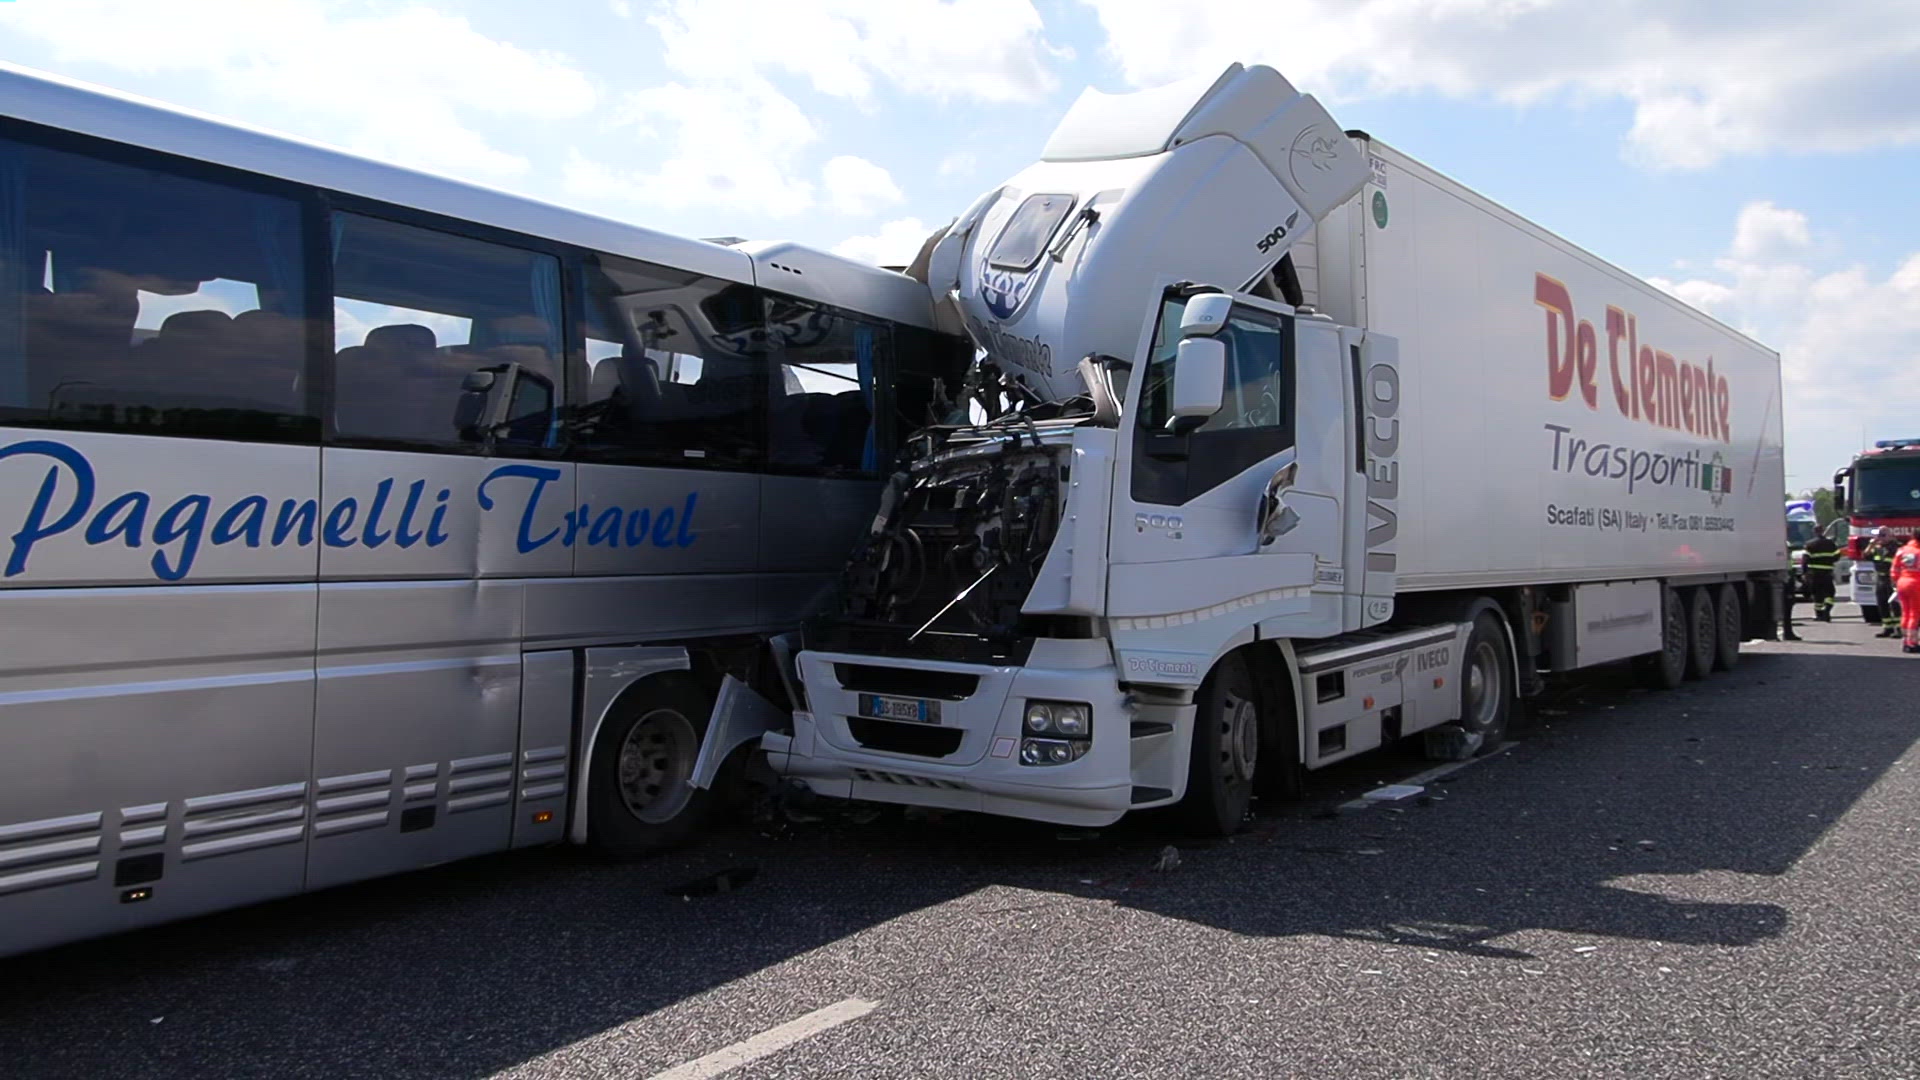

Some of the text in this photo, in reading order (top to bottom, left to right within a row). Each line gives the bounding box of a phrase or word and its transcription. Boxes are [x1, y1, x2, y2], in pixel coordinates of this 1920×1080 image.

[1256, 226, 1287, 254] 500
[1534, 271, 1731, 444] De Clemente
[1365, 363, 1400, 573] IVECO
[1544, 422, 1700, 495] Trasporti
[0, 440, 699, 582] Paganelli Travel
[1547, 504, 1595, 527] Scafati
[1598, 507, 1623, 532] (SA)
[1625, 510, 1648, 533] Italy
[1417, 646, 1450, 673] IVECO
